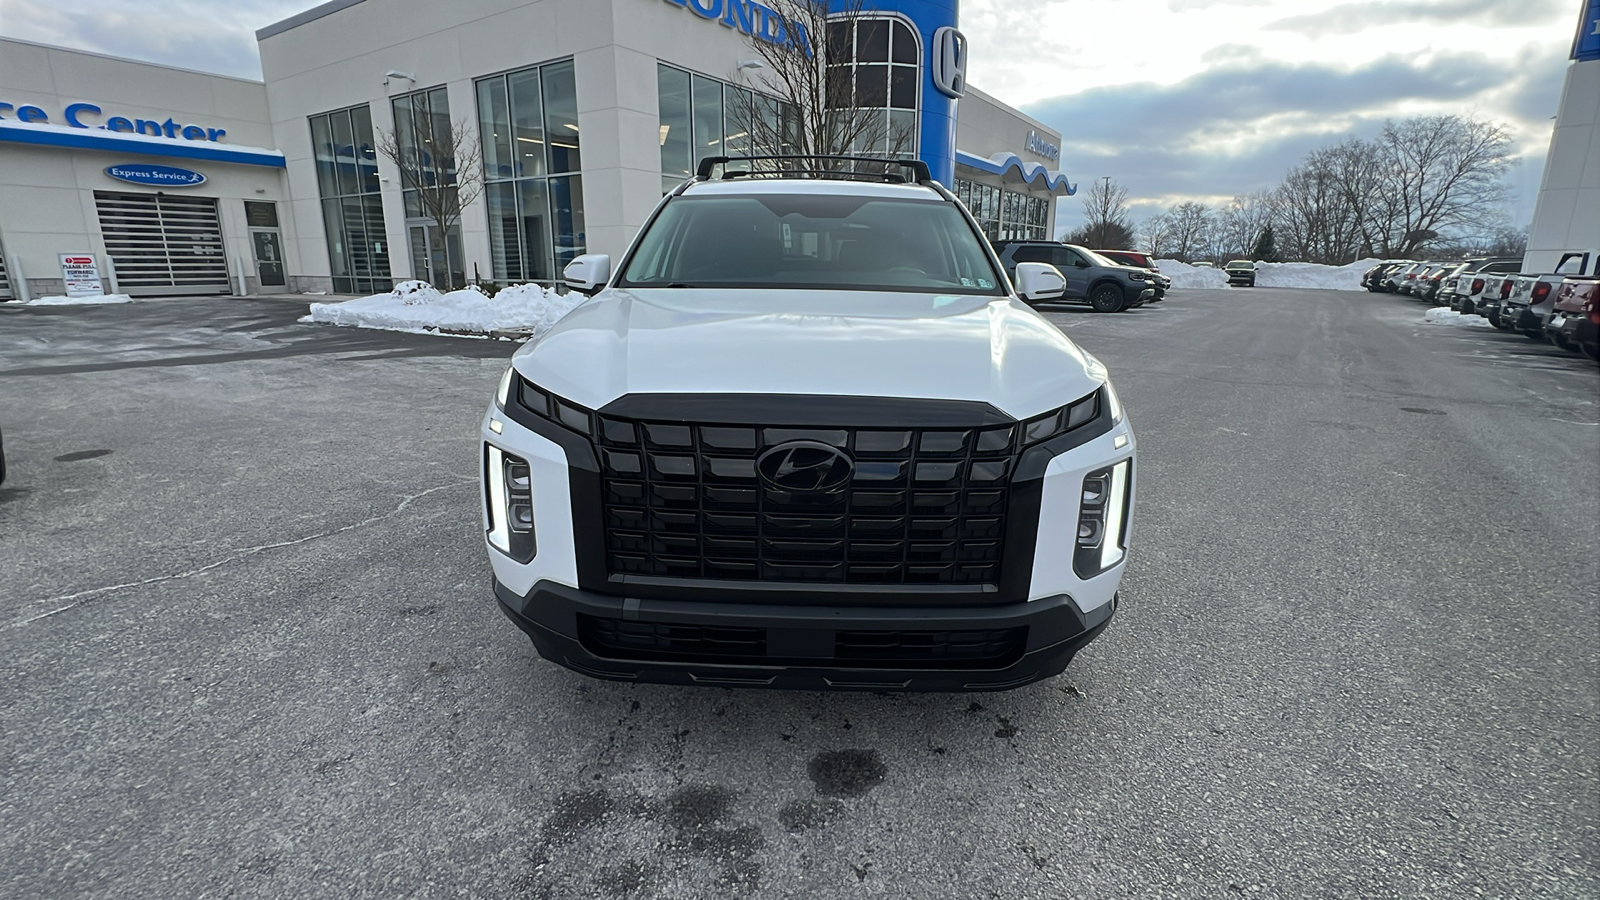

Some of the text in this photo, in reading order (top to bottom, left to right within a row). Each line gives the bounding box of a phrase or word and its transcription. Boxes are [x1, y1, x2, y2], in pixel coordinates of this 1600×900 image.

[664, 0, 814, 58] NDA
[64, 102, 227, 142] Center
[112, 167, 187, 180] Express Service
